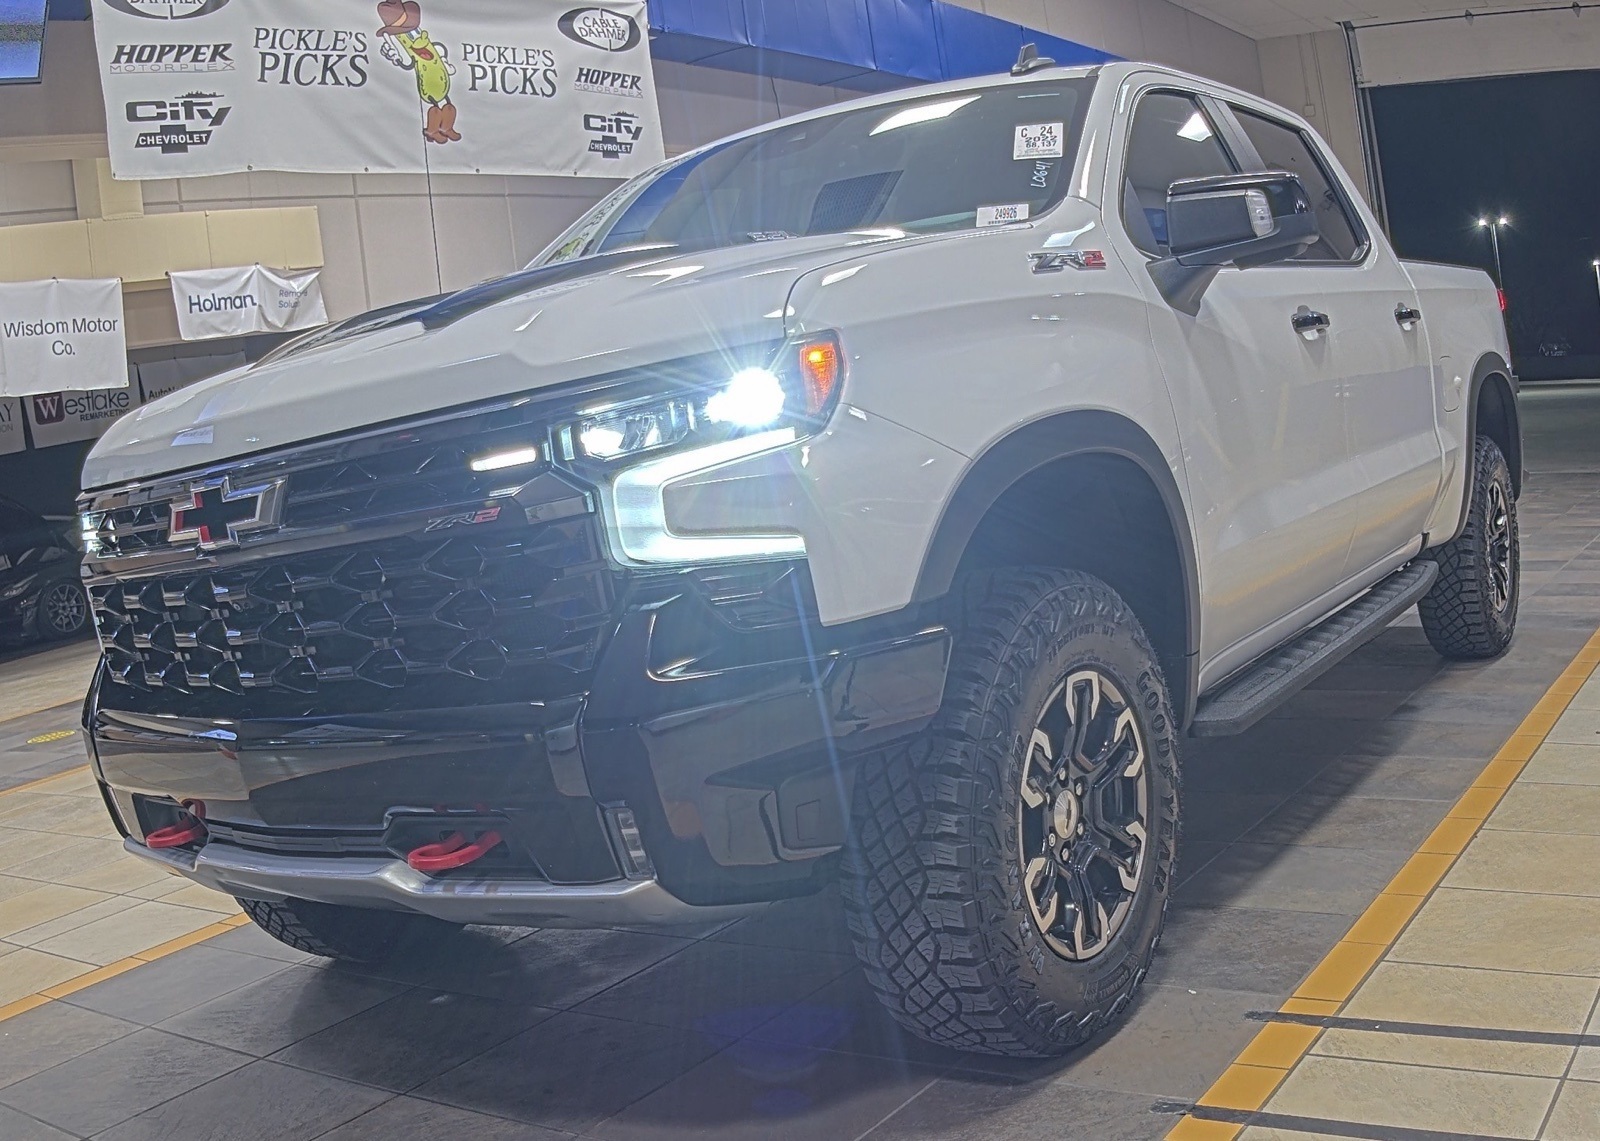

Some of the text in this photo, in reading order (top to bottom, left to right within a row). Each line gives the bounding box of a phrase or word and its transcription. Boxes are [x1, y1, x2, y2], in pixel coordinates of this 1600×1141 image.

[578, 26, 626, 41] DAHMER
[583, 17, 621, 29] CABLE
[253, 27, 367, 52] PICKLE'S
[110, 43, 233, 64] HOPPER
[462, 43, 555, 68] PICKLE'S
[110, 62, 236, 73] MOTORPLEX
[257, 51, 370, 88] PICKS
[575, 67, 641, 90] HOPPER
[468, 64, 558, 98] PICKS
[574, 83, 643, 98] MOTORPLEX
[126, 100, 232, 126] City
[583, 114, 643, 140] City
[1021, 126, 1053, 138] C 24
[139, 133, 208, 146] CHEVROLET
[590, 142, 632, 153] CHEVROLET
[1028, 251, 1106, 274] ZR2
[4, 318, 118, 338] Wisdom Motor
[52, 340, 75, 356] Co.
[36, 391, 129, 419] Westlake
[424, 507, 501, 533] ZR2
[1137, 671, 1175, 893] GOODYEAR
